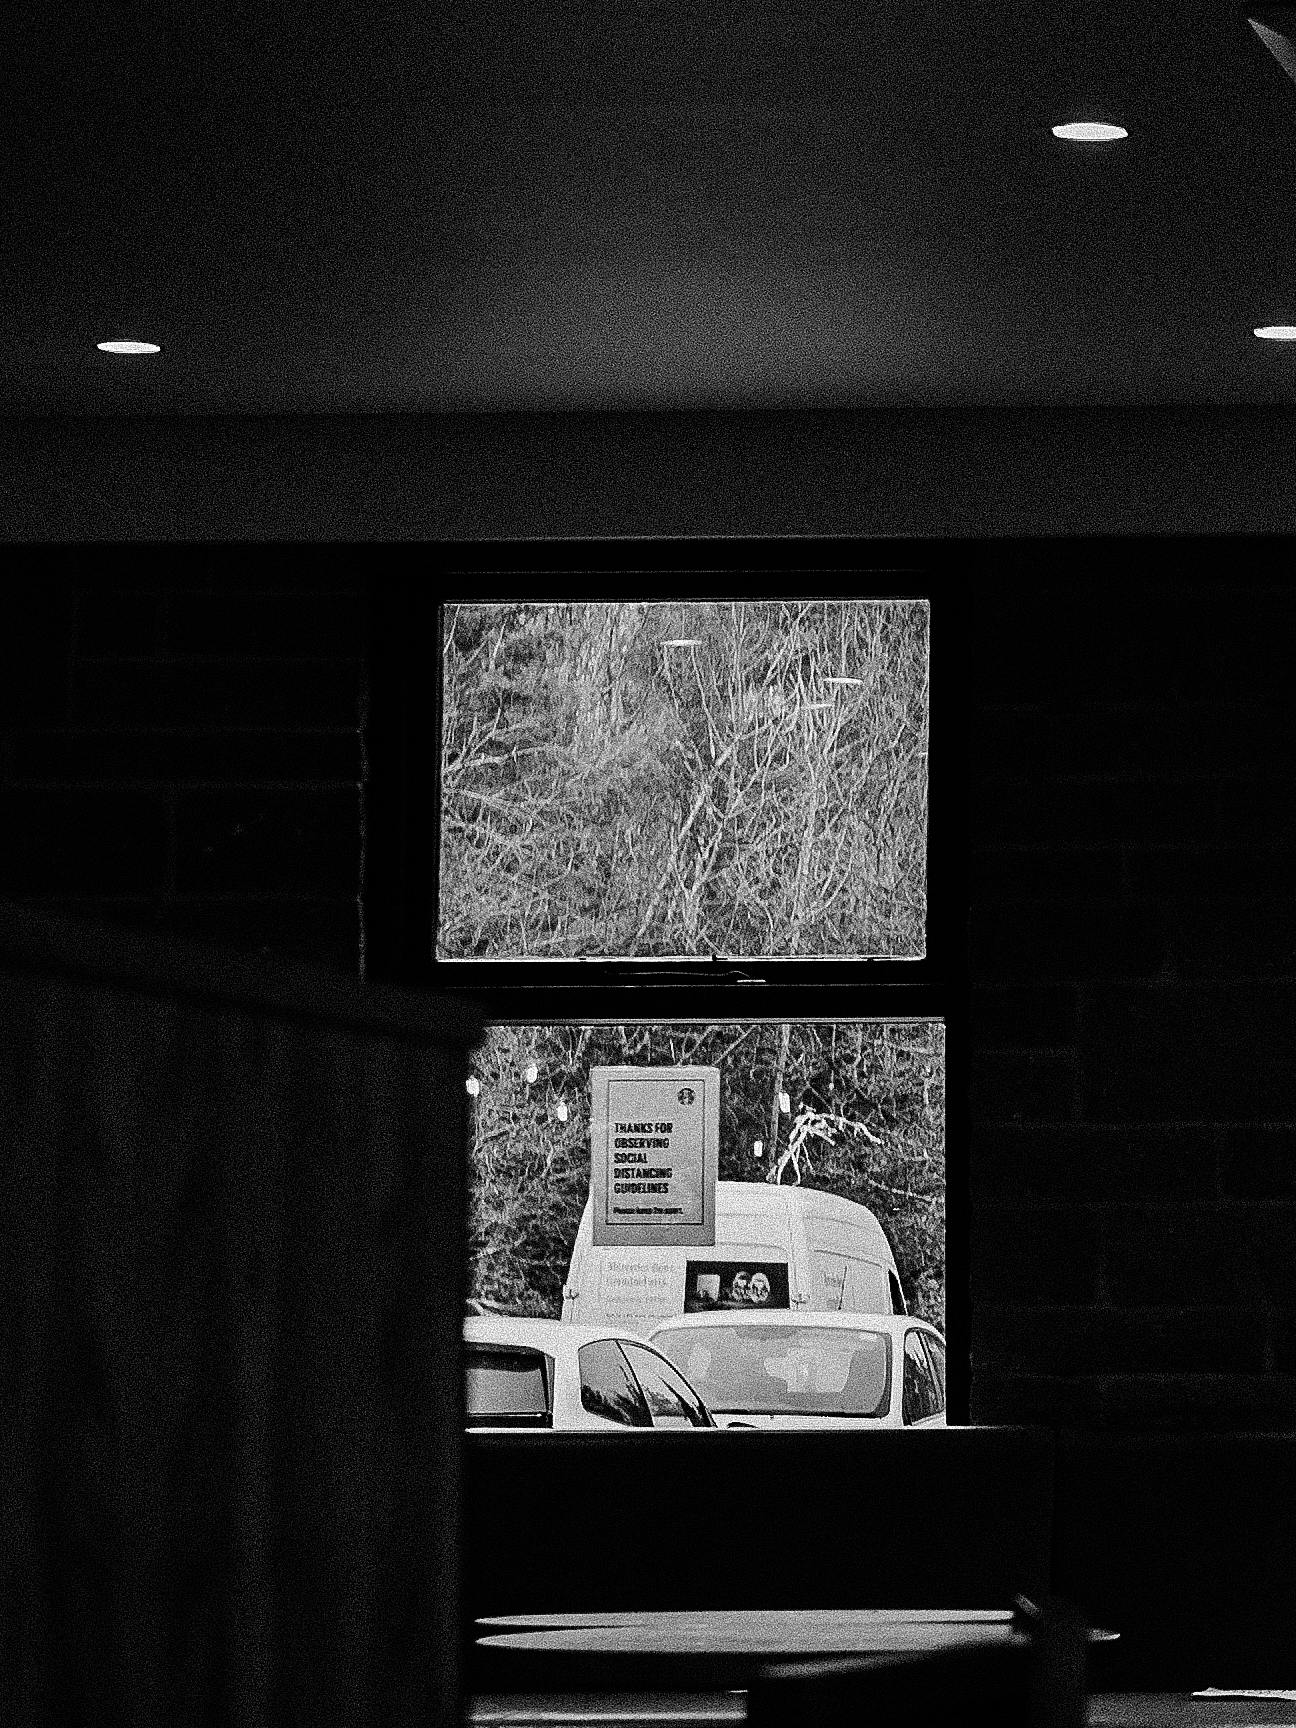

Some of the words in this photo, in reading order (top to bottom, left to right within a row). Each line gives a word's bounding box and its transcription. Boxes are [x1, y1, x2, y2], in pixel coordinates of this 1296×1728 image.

[614, 1122, 653, 1134] THANKS
[655, 1122, 674, 1134] FOR
[613, 1137, 670, 1149] OBSERVING
[613, 1152, 648, 1164] SOCIAL
[613, 1167, 673, 1179] DISTANCING
[613, 1182, 669, 1194] GUIDELINES
